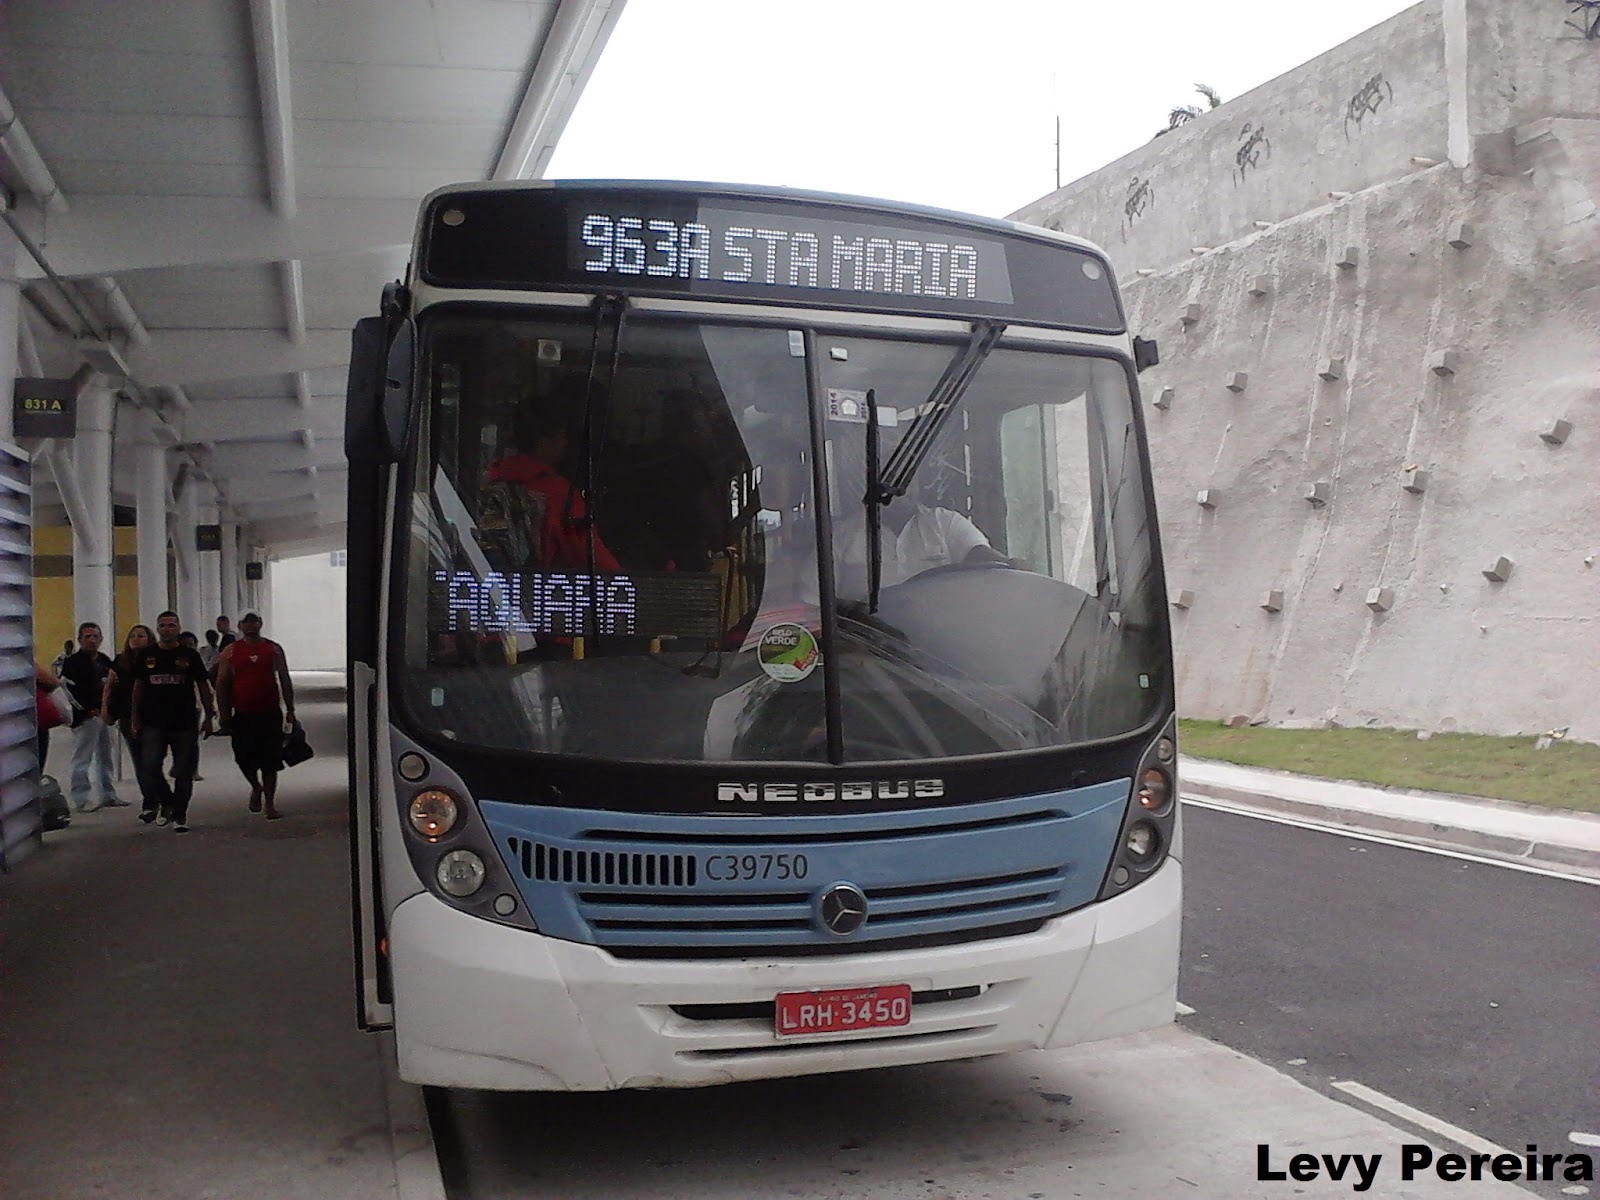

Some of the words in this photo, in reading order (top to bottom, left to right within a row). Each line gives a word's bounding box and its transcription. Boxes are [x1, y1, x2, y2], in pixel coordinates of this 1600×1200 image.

[581, 213, 711, 280] 963A
[722, 225, 820, 288] STA
[830, 234, 979, 299] MARIA
[25, 399, 47, 410] 831
[51, 400, 62, 410] A
[717, 779, 945, 802] NEOBUS
[705, 854, 808, 881] C39750
